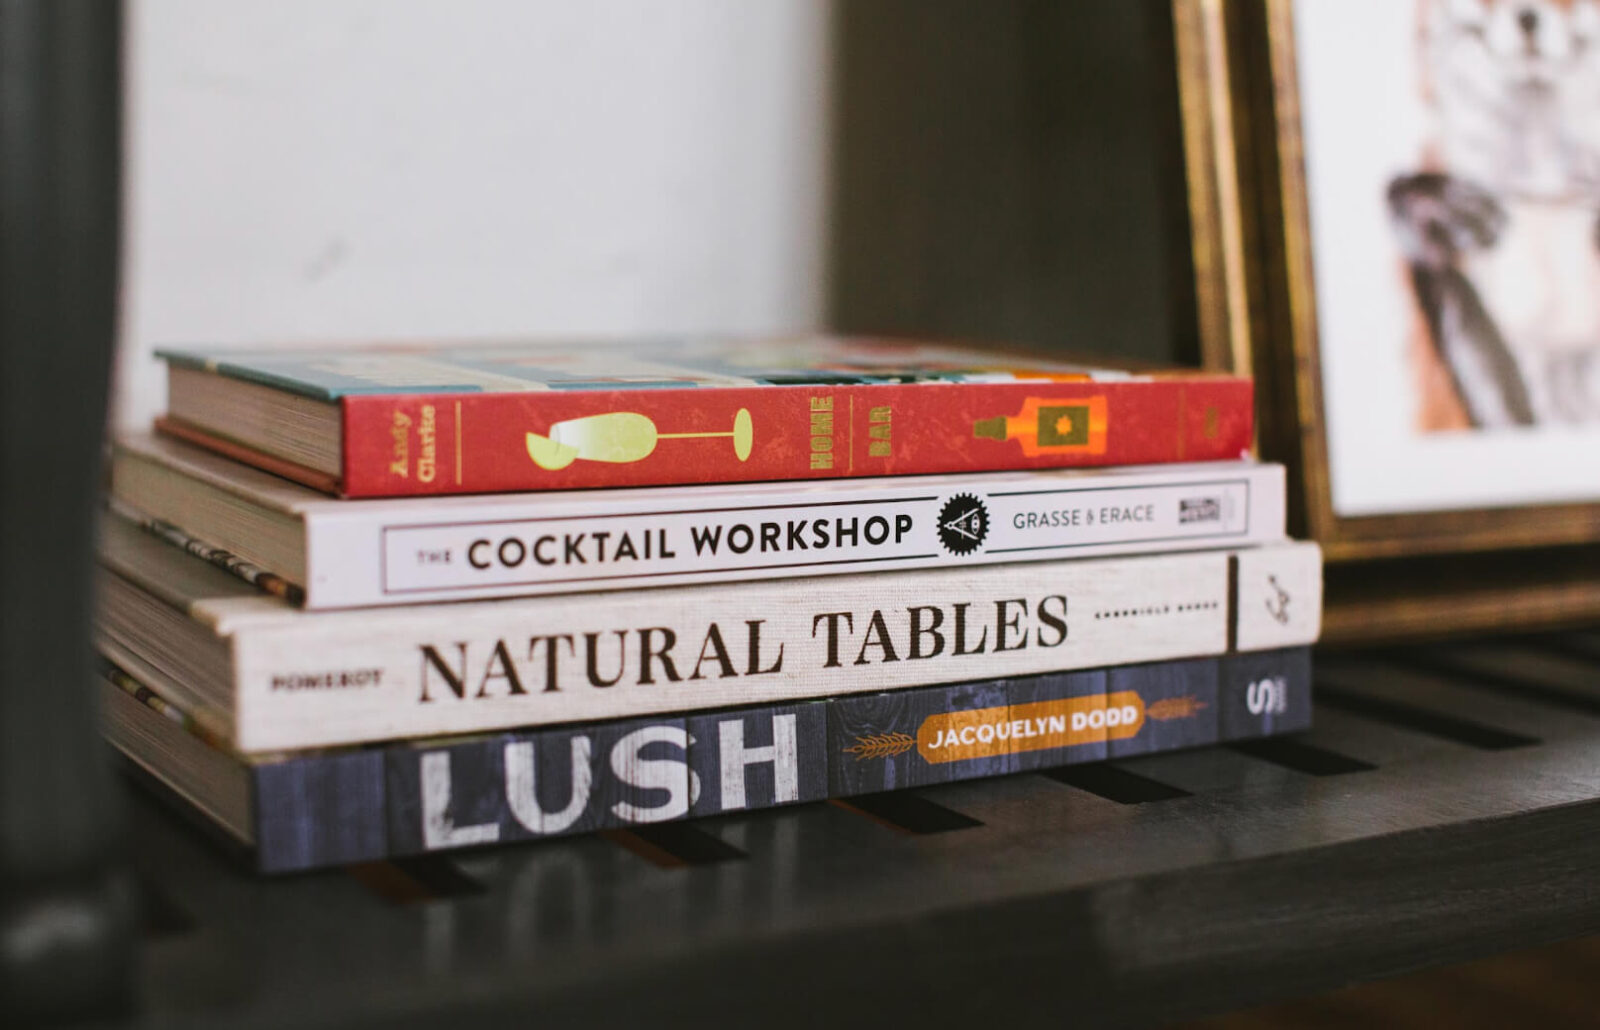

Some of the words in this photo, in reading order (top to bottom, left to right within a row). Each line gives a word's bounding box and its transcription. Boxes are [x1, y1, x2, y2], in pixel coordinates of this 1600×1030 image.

[810, 396, 834, 470] HOME
[868, 406, 892, 456] BAR
[467, 528, 676, 570] COCKTAIL
[690, 514, 913, 558] WORKSHOP
[1013, 508, 1081, 530] GRASSE
[1099, 504, 1155, 524] ERACE
[418, 619, 784, 703] NATURAL
[812, 595, 1070, 669] TABLES
[927, 714, 1066, 750] JACQUELYN
[1071, 705, 1139, 732] DODD
[419, 713, 799, 851] LUSH
